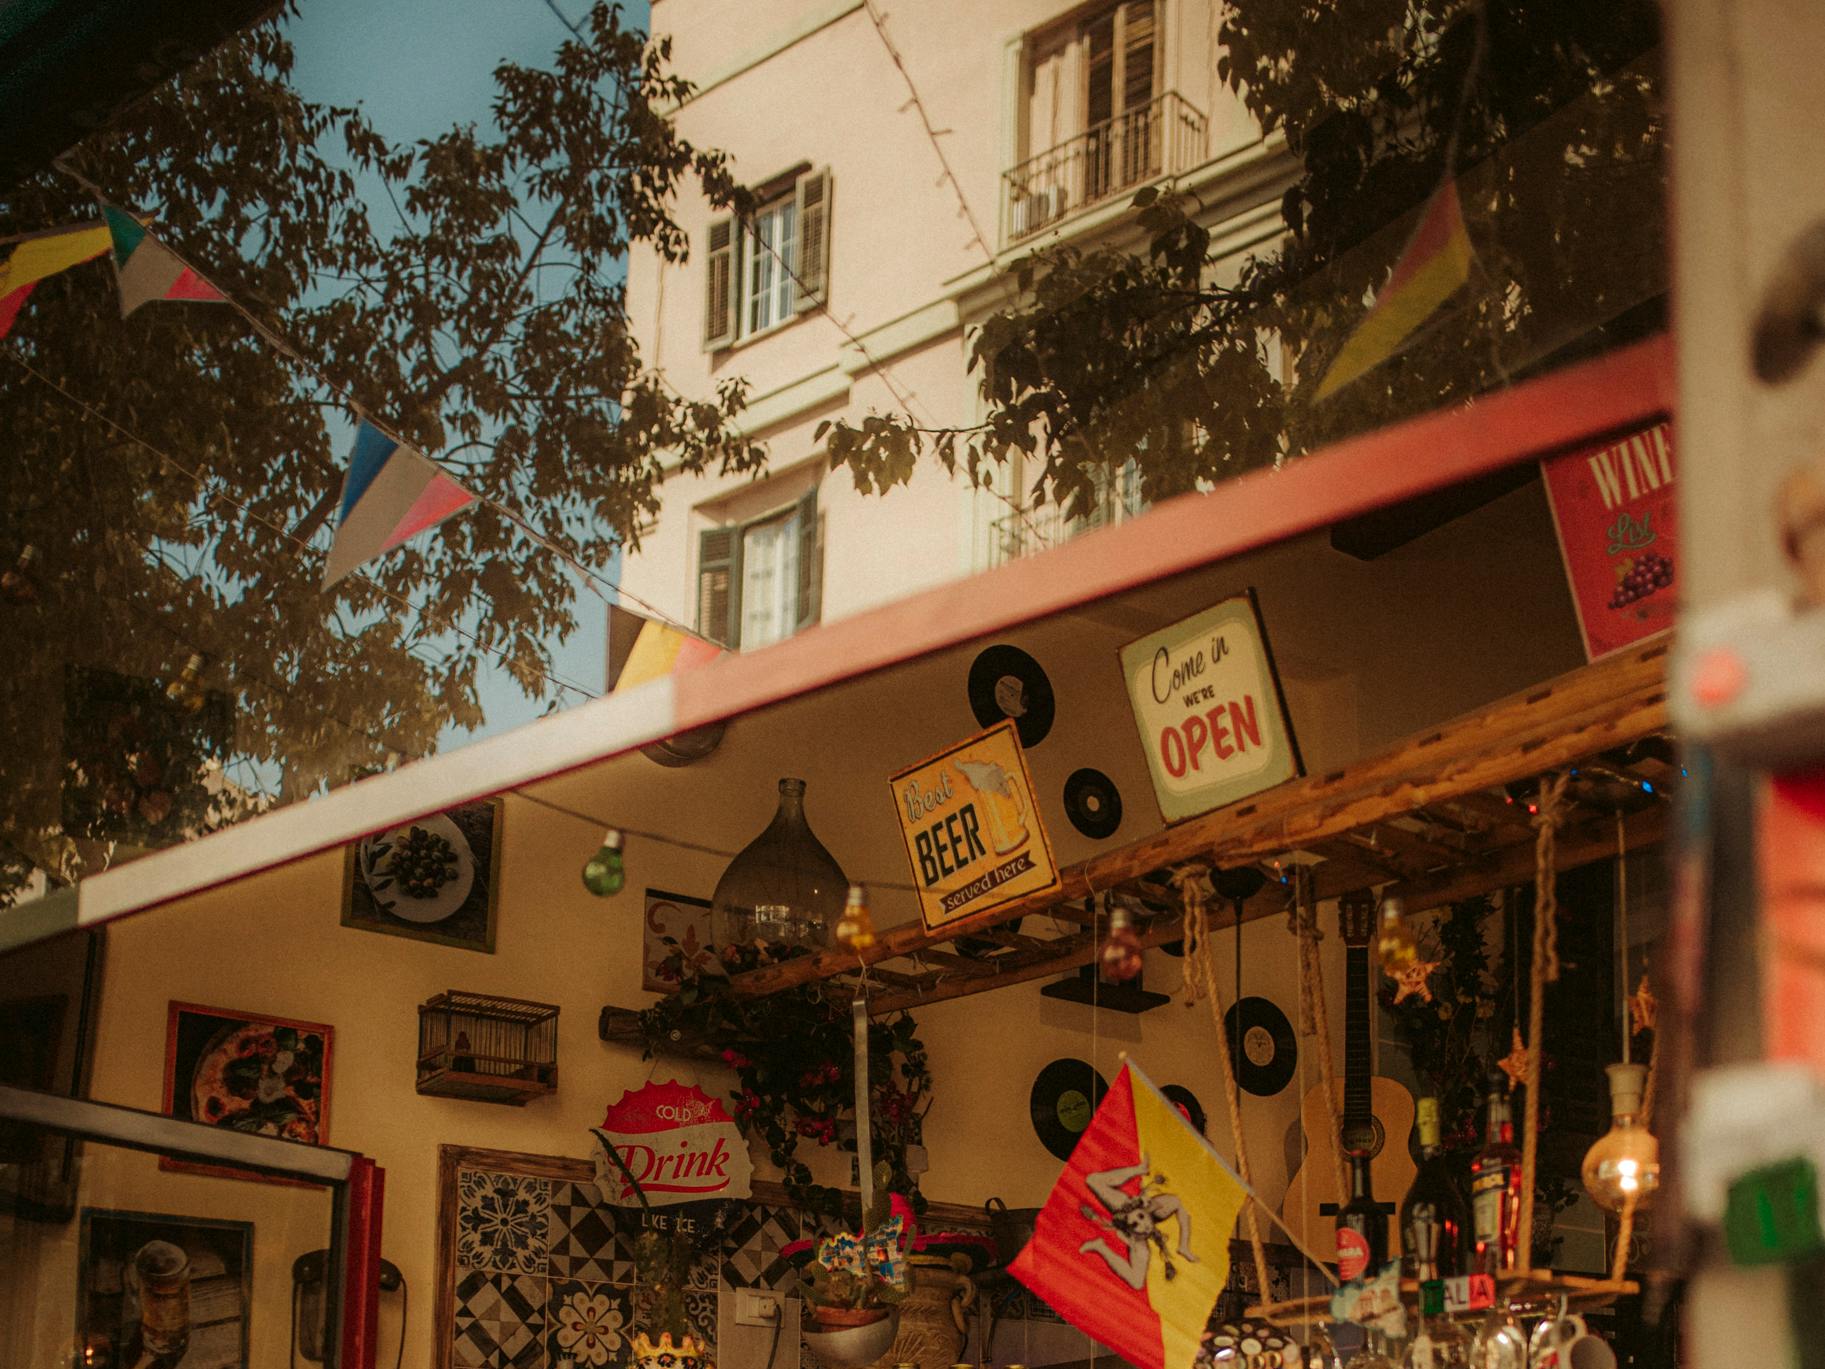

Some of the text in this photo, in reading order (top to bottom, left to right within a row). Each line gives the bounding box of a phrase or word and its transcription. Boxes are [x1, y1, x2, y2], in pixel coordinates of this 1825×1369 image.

[1152, 636, 1229, 704] Come in
[1183, 685, 1215, 707] WE'RE
[1161, 695, 1261, 778] OPEN
[904, 771, 954, 824] Best
[915, 803, 986, 887] BEER
[946, 855, 1026, 911] served here
[656, 1104, 691, 1122] COLD
[607, 1138, 730, 1192] Drink
[641, 1213, 668, 1231] LKE
